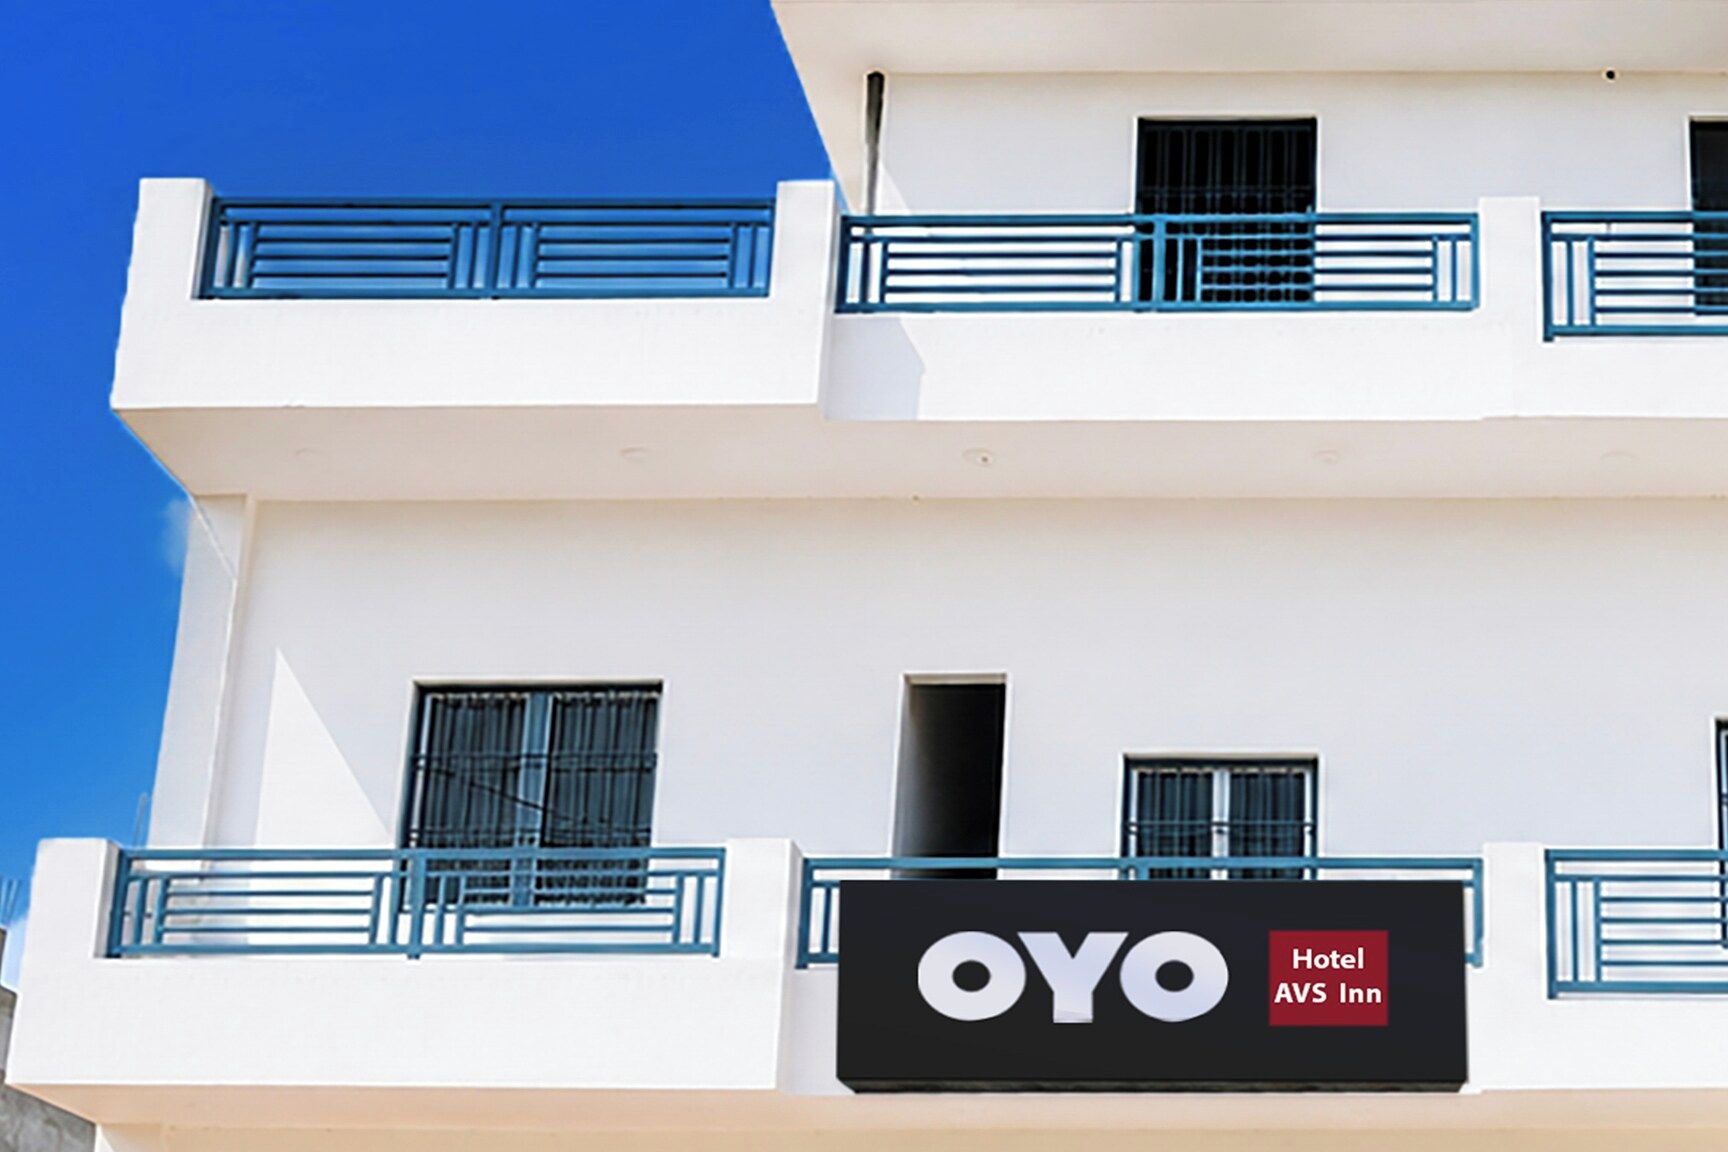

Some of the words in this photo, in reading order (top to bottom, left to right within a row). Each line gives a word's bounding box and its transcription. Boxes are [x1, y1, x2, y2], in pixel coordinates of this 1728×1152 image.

[1292, 947, 1365, 970] Hotel
[918, 931, 1229, 1023] OYO
[1274, 982, 1327, 1004] AVS
[1339, 983, 1382, 1004] Inn
